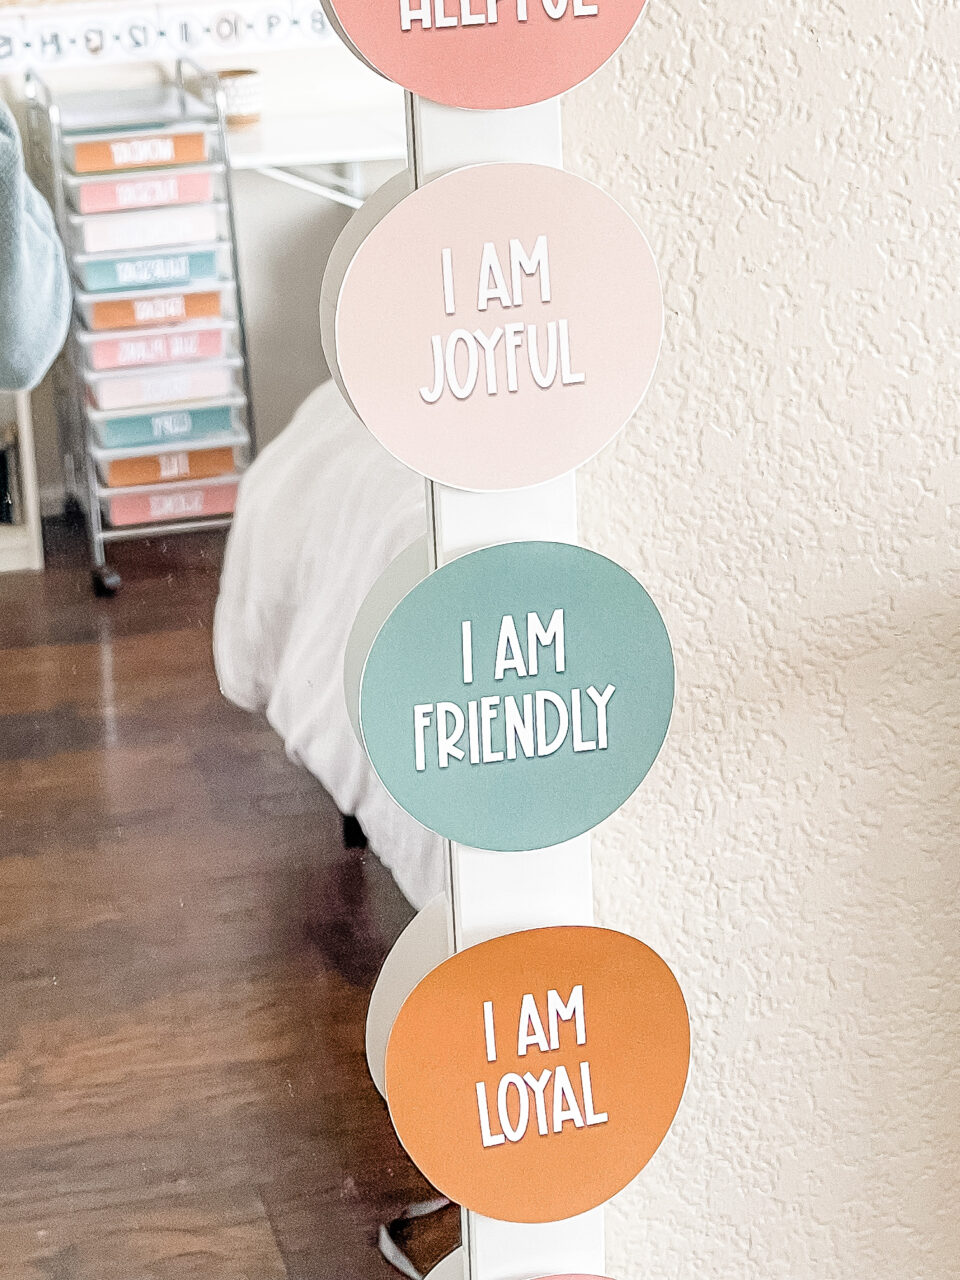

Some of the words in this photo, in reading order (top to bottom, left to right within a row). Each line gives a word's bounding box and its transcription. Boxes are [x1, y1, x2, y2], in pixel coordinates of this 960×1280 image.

[442, 247, 455, 314] I
[477, 235, 551, 310] AM
[419, 318, 585, 402] JOYFUL
[461, 620, 473, 683] I
[494, 608, 565, 680] AM
[413, 684, 616, 771] FRIENDLY
[483, 1001, 497, 1062] I
[517, 984, 586, 1056] AM
[475, 1061, 609, 1148] LOYAL
